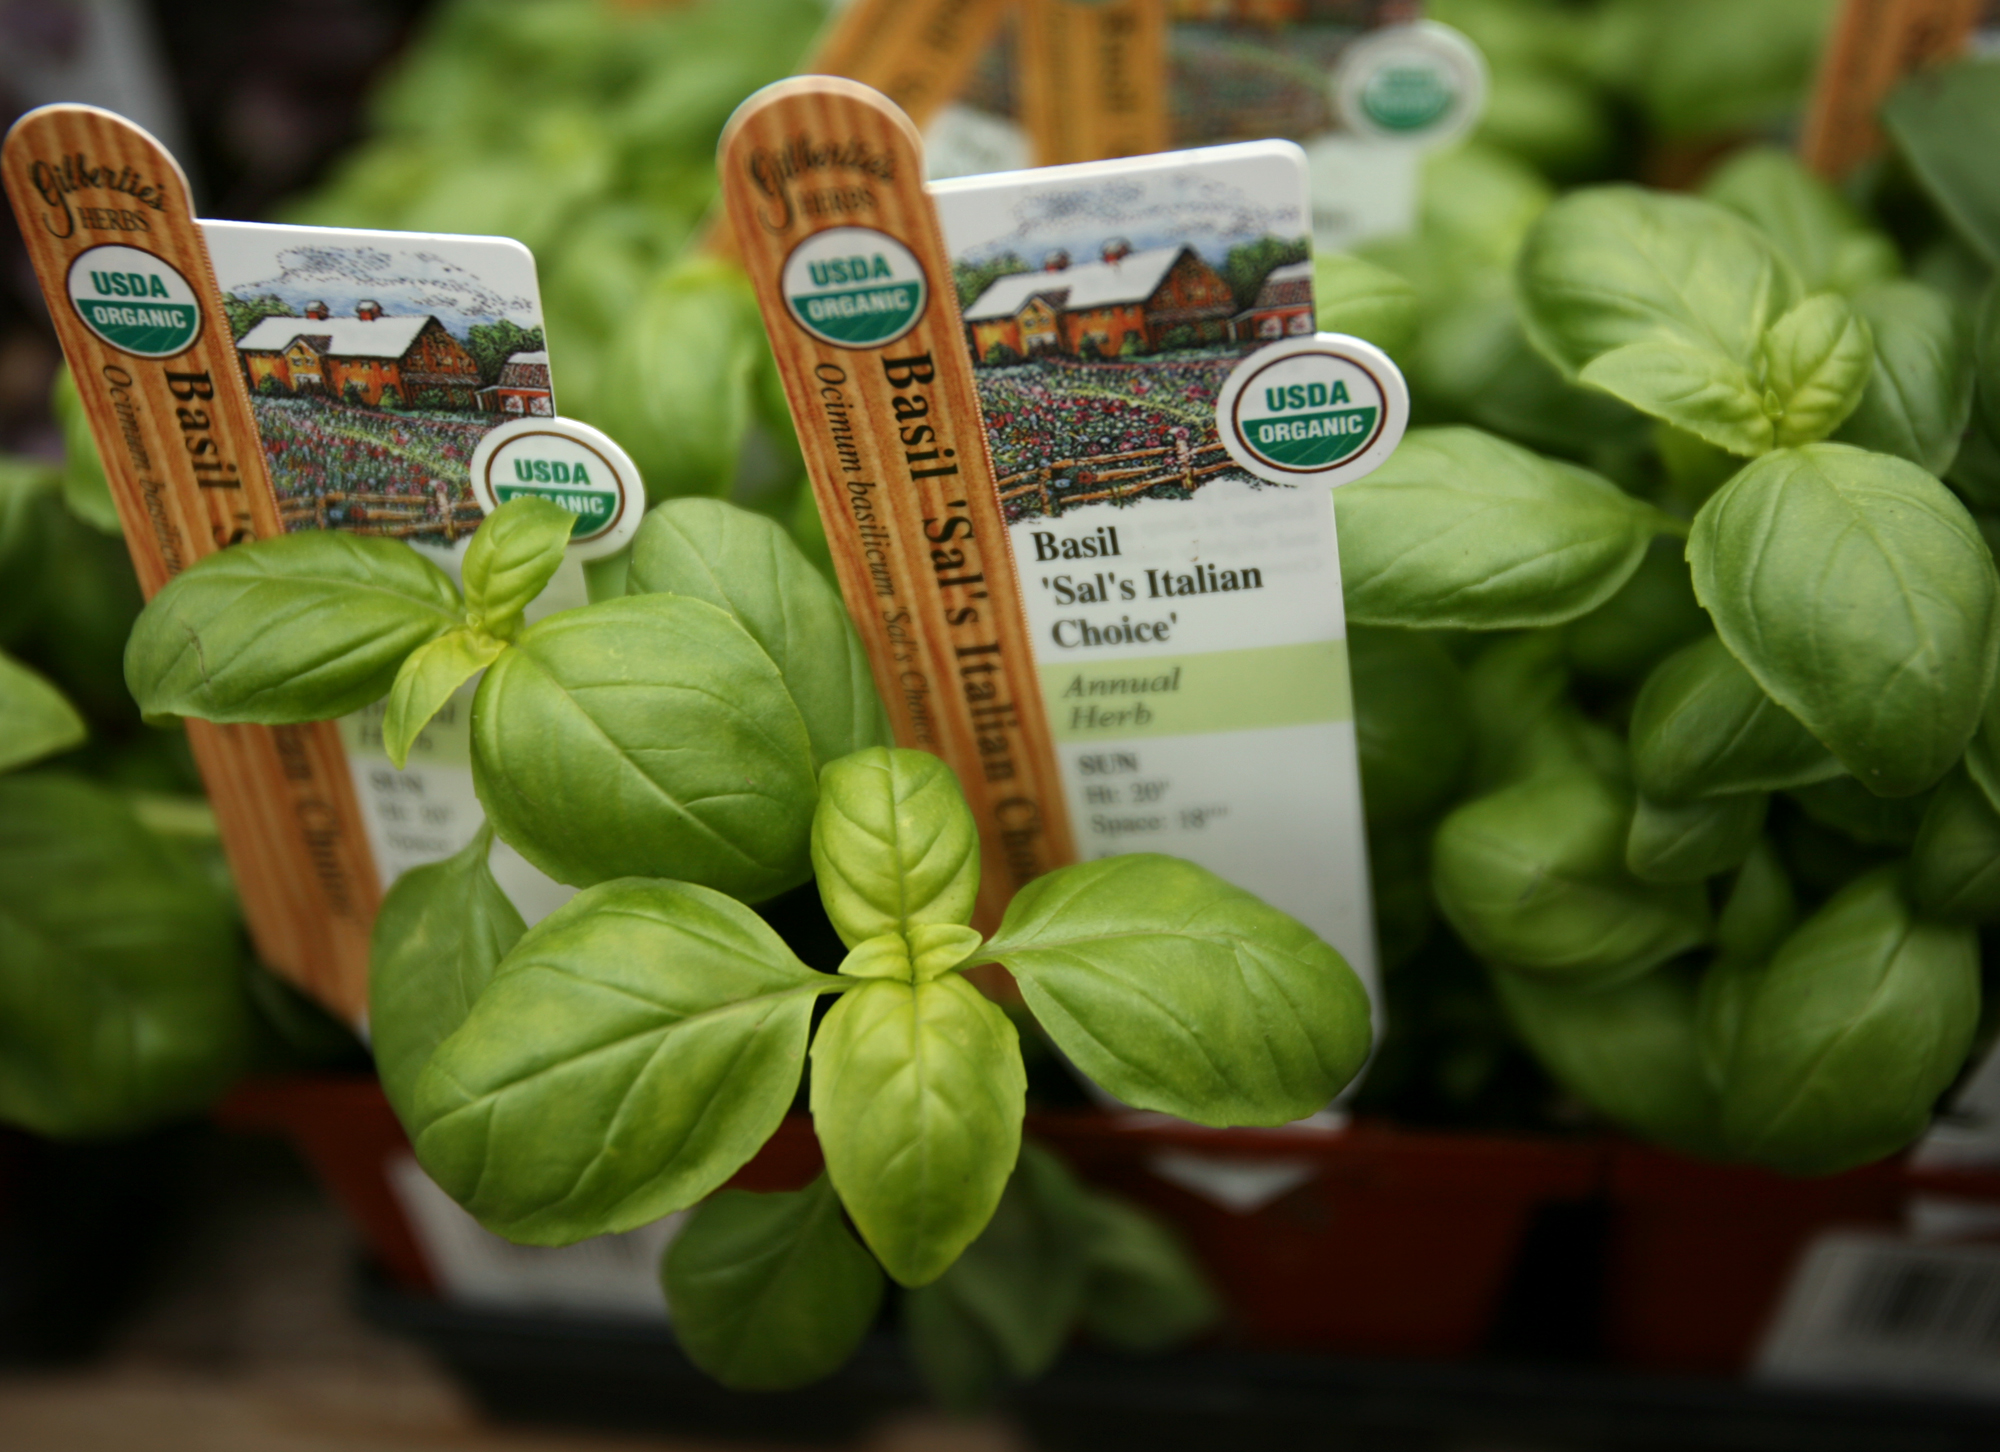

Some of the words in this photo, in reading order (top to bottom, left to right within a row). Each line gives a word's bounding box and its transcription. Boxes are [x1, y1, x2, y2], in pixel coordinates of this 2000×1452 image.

[90, 271, 169, 298] USDA
[809, 254, 891, 286] USDA
[92, 304, 187, 330] ORGANIC
[808, 288, 910, 321] ORGANIC
[1266, 380, 1350, 412] USDA
[163, 367, 240, 490] Basil
[1259, 415, 1363, 444] ORGANIC
[513, 457, 592, 486] USDA
[815, 363, 861, 473] Ocimum
[847, 481, 895, 598] basilicum
[510, 491, 605, 515] ANIC
[1032, 526, 1121, 561] Basil
[881, 351, 958, 482] Basil
[922, 500, 988, 626] 'Sal's
[956, 641, 1018, 781] Italian
[1041, 570, 1137, 606] 'Sal's
[1143, 562, 1265, 600] Italian
[1051, 611, 1179, 650] Choice'
[1062, 666, 1184, 700] Annual
[1068, 702, 1155, 731] Herb
[1078, 752, 1140, 777] SUN
